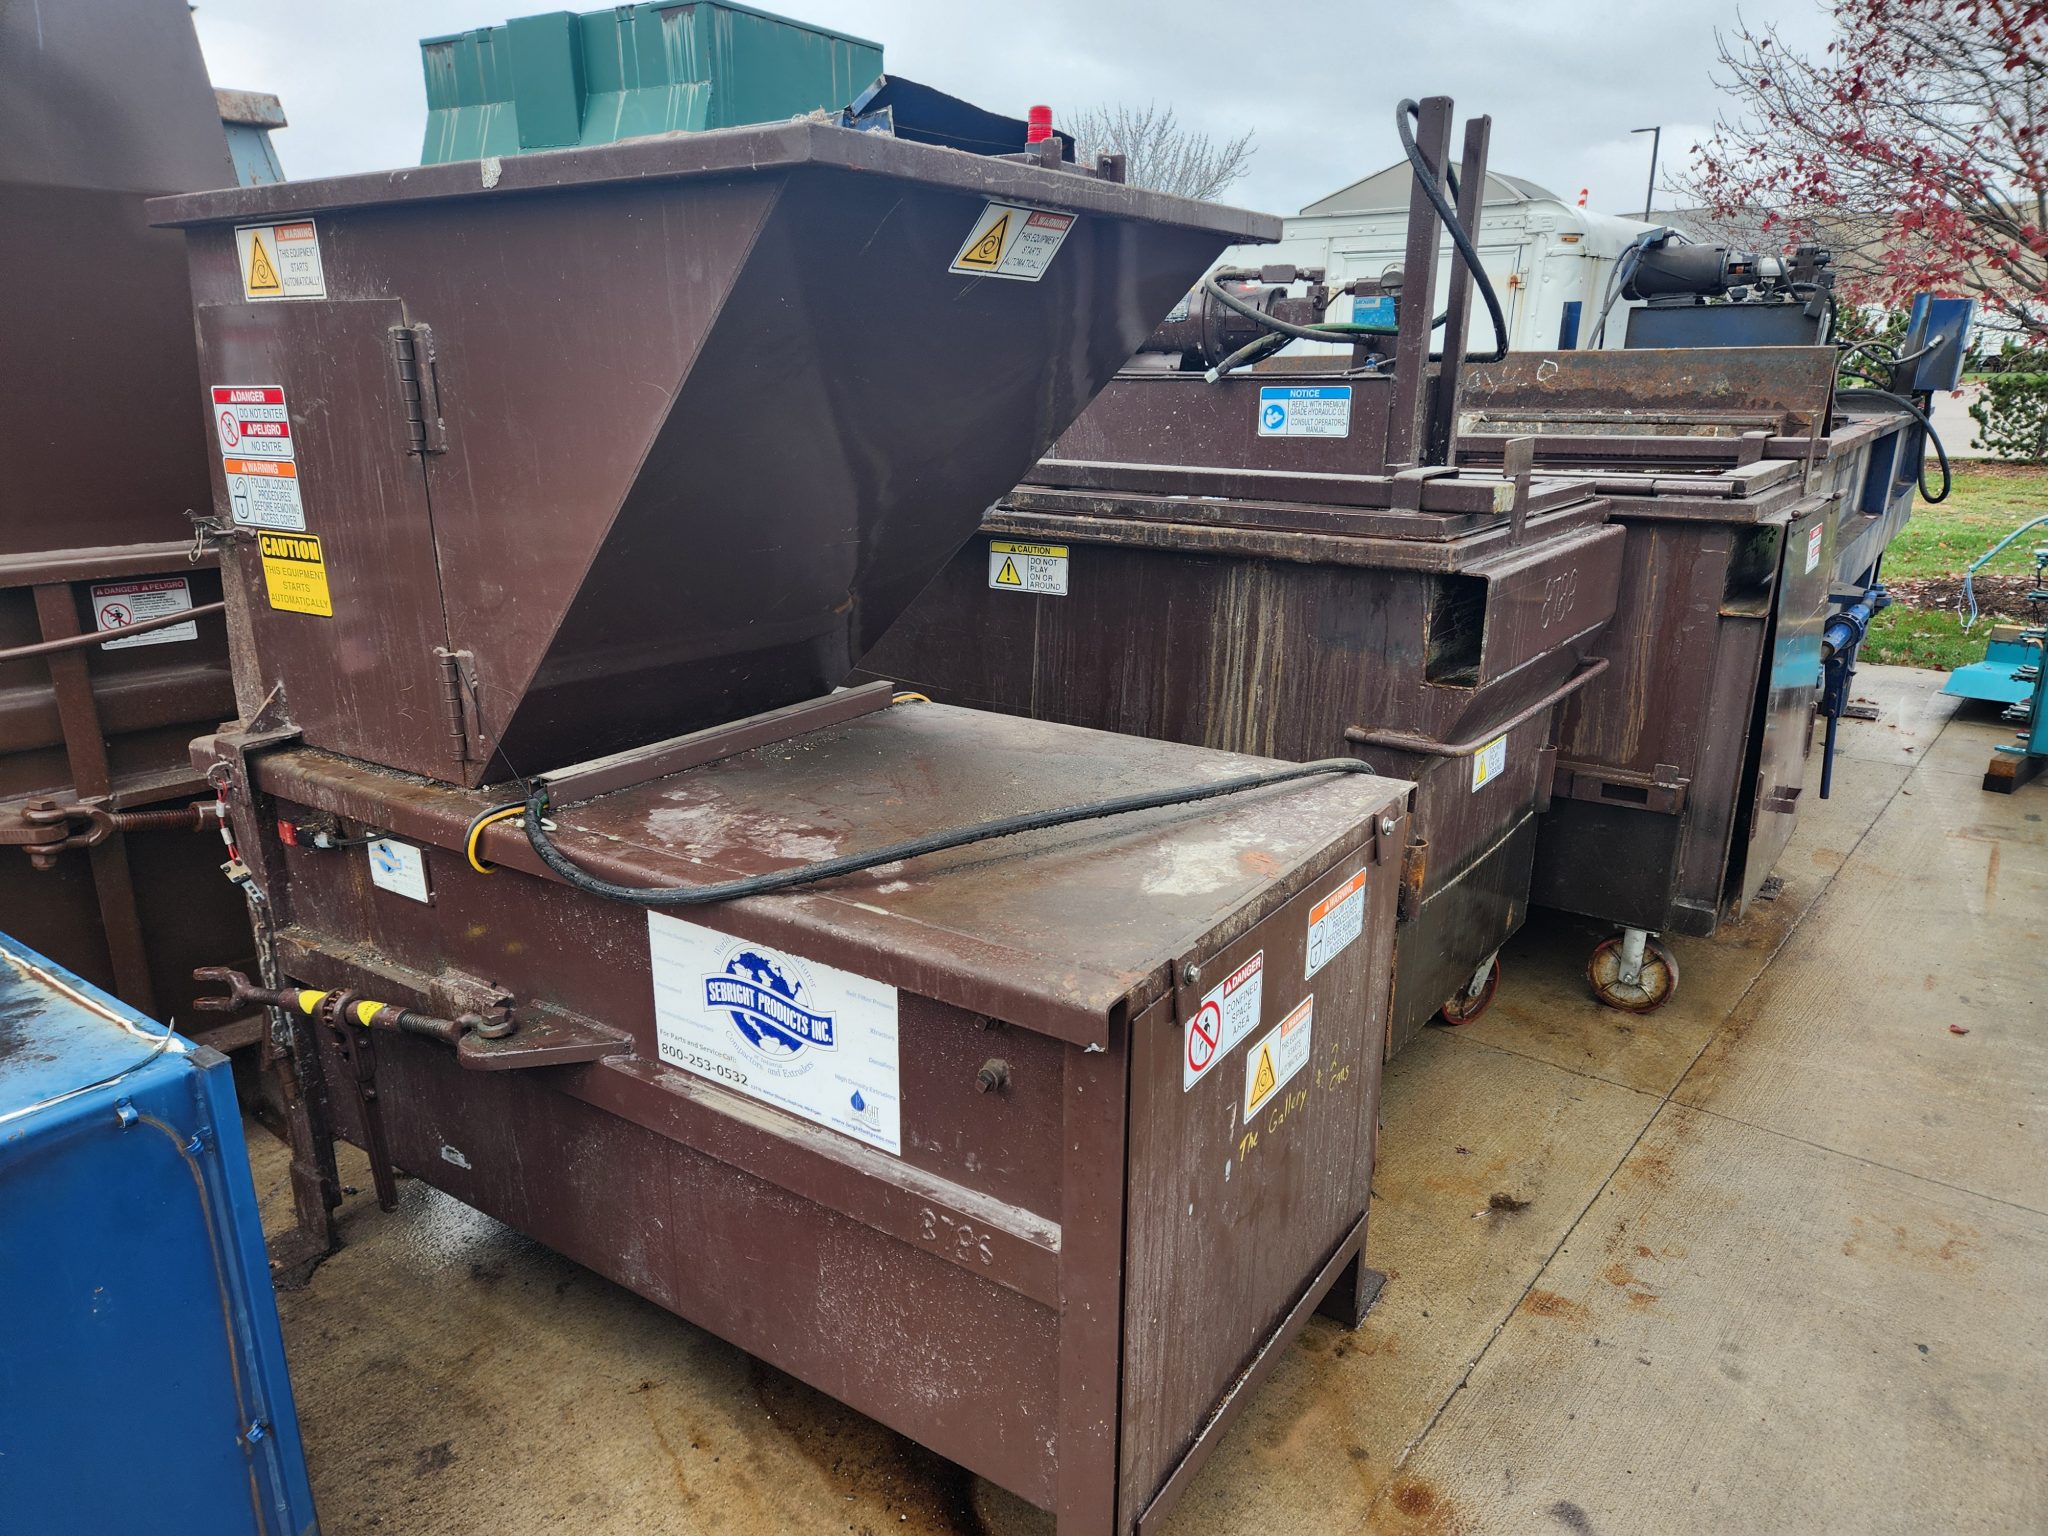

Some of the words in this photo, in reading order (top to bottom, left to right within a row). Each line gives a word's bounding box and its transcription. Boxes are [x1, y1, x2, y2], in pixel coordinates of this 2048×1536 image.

[1038, 216, 1069, 229] WARNING
[284, 227, 313, 239] WARNING
[279, 249, 289, 258] THIS
[1022, 246, 1042, 256] STARTS
[291, 262, 308, 272] STARTS
[284, 276, 320, 286] AUTOMATICALLY
[236, 391, 266, 402] DANGER
[1290, 389, 1320, 398] NOTICE
[239, 408, 248, 418] DO
[249, 408, 261, 418] NOT
[263, 408, 284, 419] ENTER
[1291, 418, 1314, 426] CONSULT
[252, 424, 281, 435] PELIGRO
[251, 441, 259, 451] NO
[262, 441, 283, 452] ENTRE
[247, 462, 279, 474] WARNING
[261, 537, 320, 560] CAUTION
[1018, 545, 1051, 554] CAUTION
[1030, 557, 1041, 565] DO
[265, 565, 281, 575] THIS
[282, 567, 325, 580] EQUIPMENT
[1029, 573, 1040, 581] ON
[104, 585, 139, 594] DANGER
[149, 581, 184, 590] PELIGRO
[283, 581, 311, 592] STARTS
[1029, 581, 1061, 590] AROUND
[271, 593, 328, 609] AUTOMATICALLY
[1231, 957, 1261, 987] DANGER
[1226, 981, 1259, 1015] CONFINED
[708, 981, 755, 1008] SEBRIGHT
[758, 992, 809, 1036] PRODUCTS
[811, 1019, 833, 1042] INC.
[1231, 999, 1252, 1024] SPACE
[1232, 1015, 1250, 1036] AREA
[660, 1028, 669, 1038] For
[670, 1033, 686, 1044] Parts
[687, 1040, 699, 1049] and
[699, 1044, 721, 1057] Service
[725, 1030, 764, 1071] Compactors
[767, 1067, 782, 1077] and
[783, 1061, 814, 1078] Extruders
[661, 1043, 749, 1087] 800-253-0532
[1239, 1131, 1258, 1162] The
[1268, 1088, 1307, 1134] Gallery
